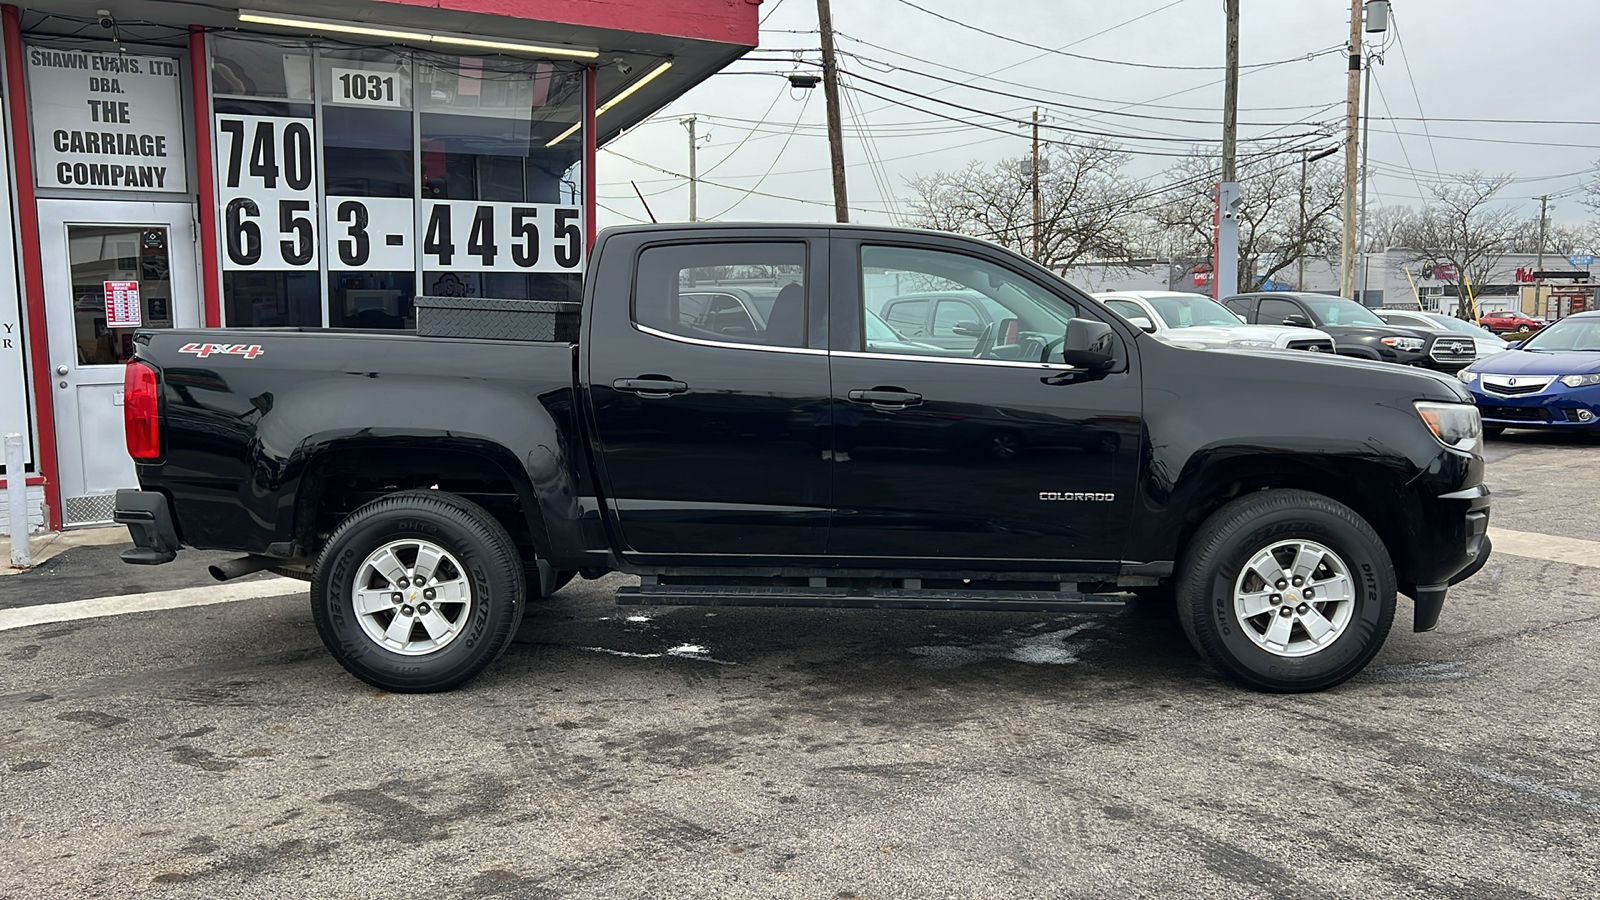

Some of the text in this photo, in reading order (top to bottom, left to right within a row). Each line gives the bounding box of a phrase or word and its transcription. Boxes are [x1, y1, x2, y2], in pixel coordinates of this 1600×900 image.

[31, 51, 177, 77] SHAWN EVANS. LTD.
[89, 77, 125, 93] DBA.
[338, 73, 394, 101] 1031
[87, 99, 130, 124] THE
[53, 129, 167, 157] CARRIAGE
[220, 119, 312, 191] 740
[56, 162, 167, 188] COMPANY
[3, 323, 14, 334] Y
[3, 338, 14, 349] R
[1039, 492, 1115, 502] COLORADO
[1361, 563, 1378, 602] DHT2
[466, 563, 490, 650] DEXTERO
[1216, 597, 1232, 637] DHT2
